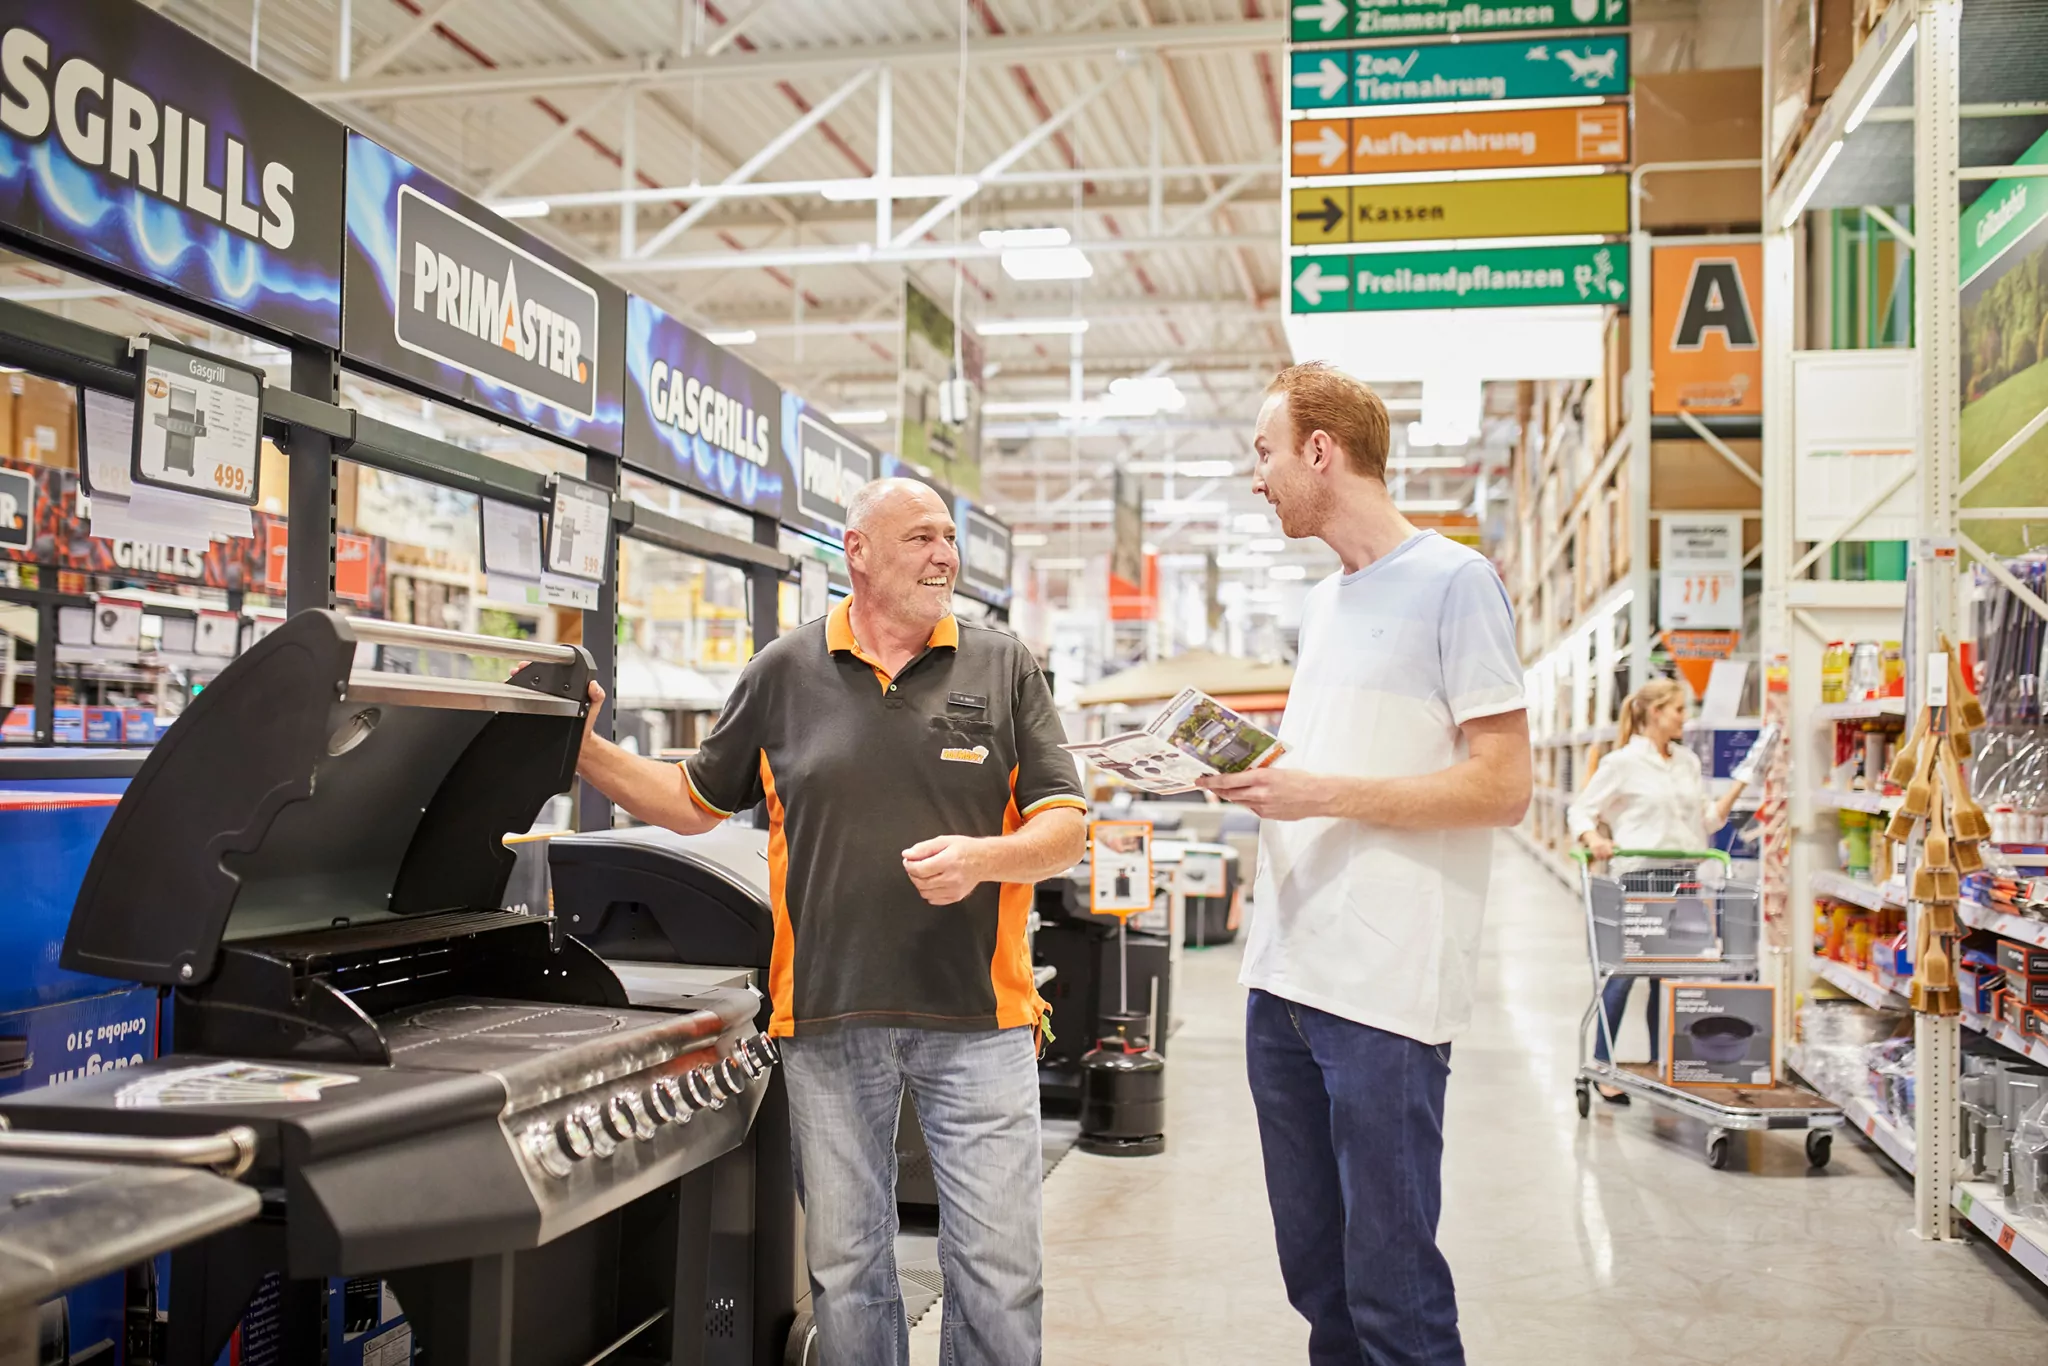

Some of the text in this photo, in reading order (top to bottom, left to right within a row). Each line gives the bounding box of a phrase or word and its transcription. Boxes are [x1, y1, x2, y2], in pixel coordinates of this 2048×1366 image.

[1355, 4, 1554, 33] Zimmerpflanzen
[1355, 49, 1420, 78] Zoo/
[1356, 73, 1506, 101] Tiernahrung
[1357, 128, 1536, 157] Aufbewahrung
[1358, 203, 1444, 223] Kassen
[1357, 265, 1564, 296] Freilandpflanzen
[1670, 257, 1759, 353] A
[189, 359, 226, 383] Gasgrill
[650, 360, 769, 467] GASGRILLS
[113, 538, 204, 579] GRILLS
[66, 1017, 147, 1052] Cordoba 510
